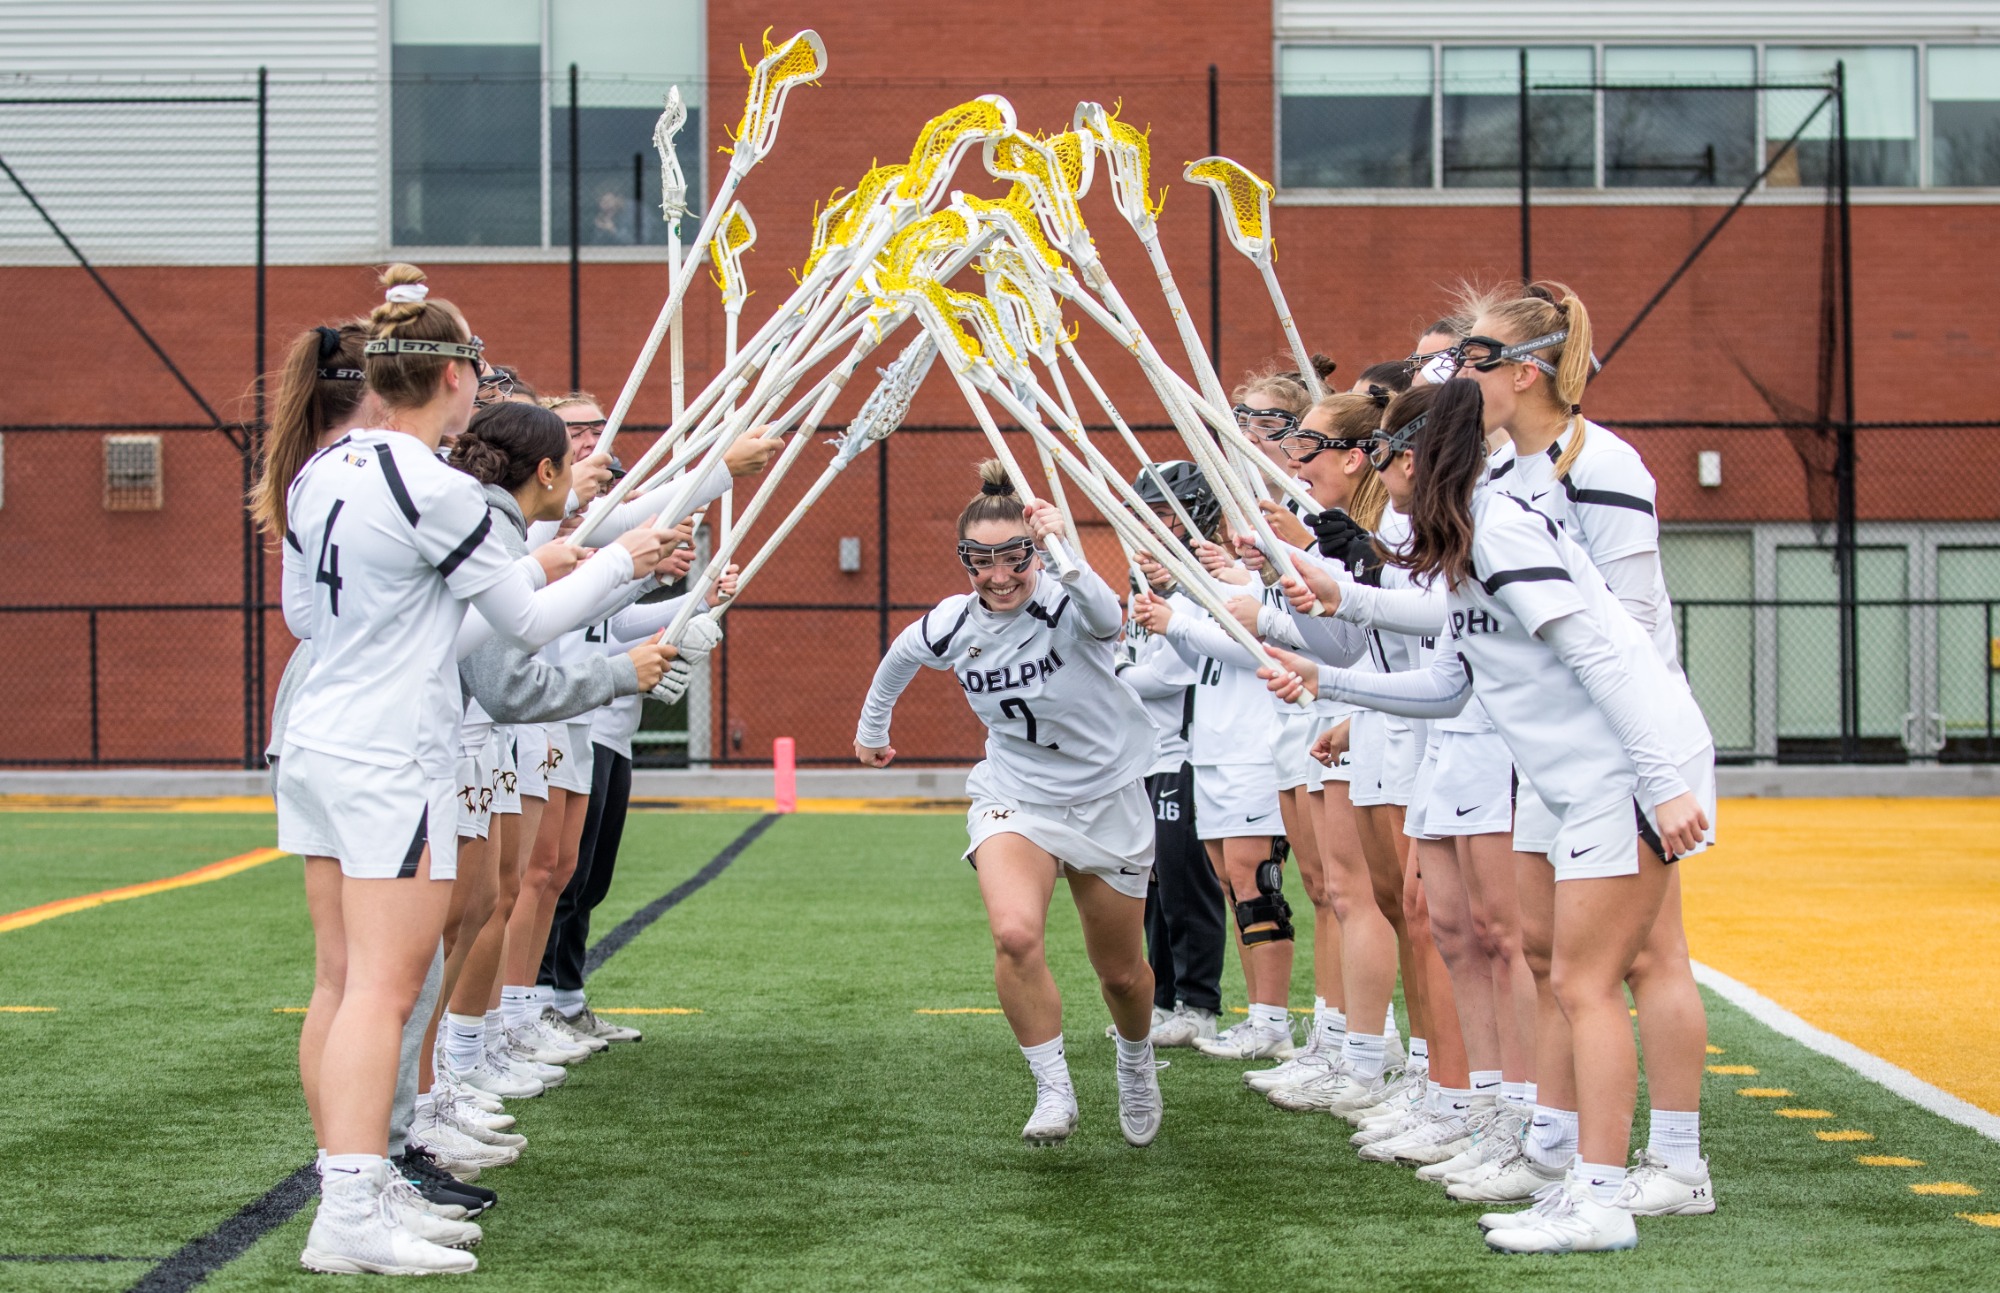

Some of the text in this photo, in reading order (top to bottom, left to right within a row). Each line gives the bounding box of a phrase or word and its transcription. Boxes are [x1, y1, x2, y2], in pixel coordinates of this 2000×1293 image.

[402, 341, 440, 353] STX
[1510, 337, 1552, 354] ARMOUR
[336, 368, 366, 379] STX
[1408, 414, 1428, 434] ST
[1356, 439, 1378, 448] ST
[315, 498, 346, 618] 4
[999, 697, 1060, 751] 2
[1156, 799, 1181, 822] 16
